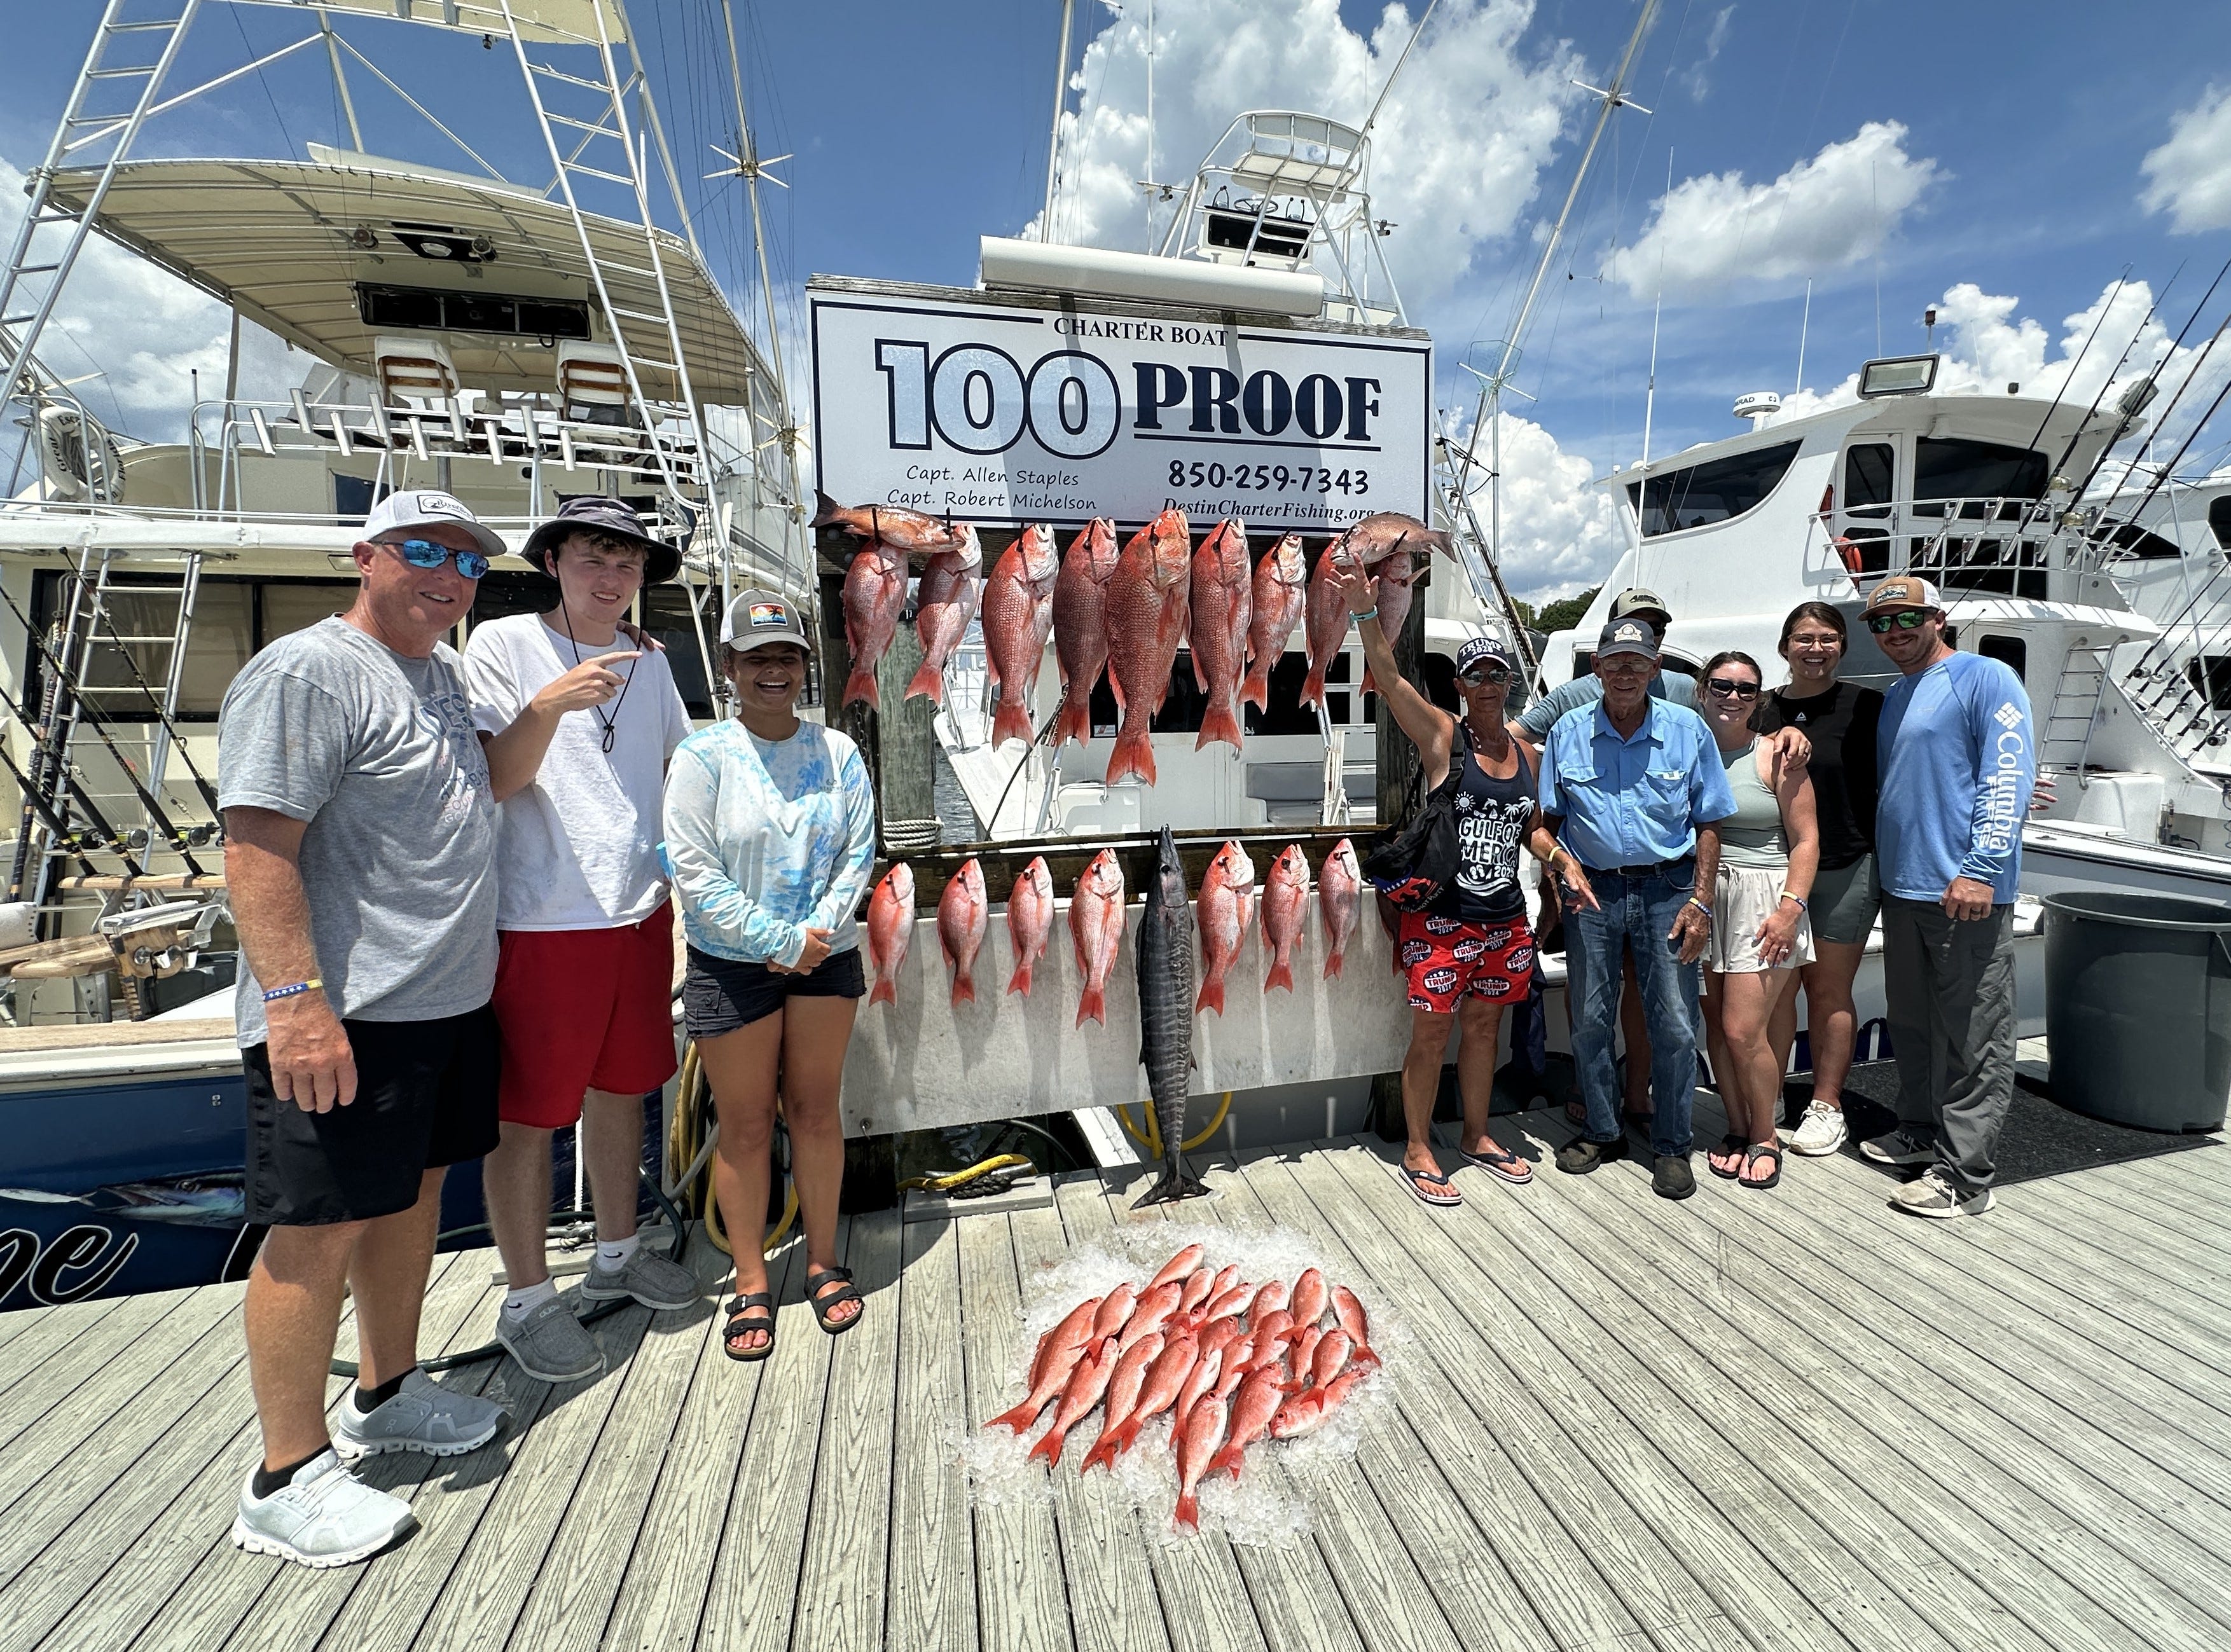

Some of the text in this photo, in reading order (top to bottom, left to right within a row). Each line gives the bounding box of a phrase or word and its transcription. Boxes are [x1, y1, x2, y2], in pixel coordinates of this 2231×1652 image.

[1053, 317, 1229, 347] CHARTER BOAT
[874, 338, 1382, 460] 100 PROOF
[906, 465, 1079, 490] Capt. Allen Staples
[1168, 460, 1369, 495] 850-259-7343
[887, 489, 1097, 509] Capt. Robert Michelson
[1163, 497, 1375, 523] DestinCharterFishing.org
[1460, 638, 1502, 657] TRUMP
[1989, 731, 2024, 850] Columbia
[1459, 817, 1522, 847] GULF OF
[1494, 865, 1515, 878] 2025
[1428, 918, 1458, 929] TRUMP
[1456, 944, 1483, 956] TRUMP
[1427, 974, 1454, 986] TRUMP
[1437, 984, 1452, 993] 2024
[1475, 982, 1507, 991] TRUMP
